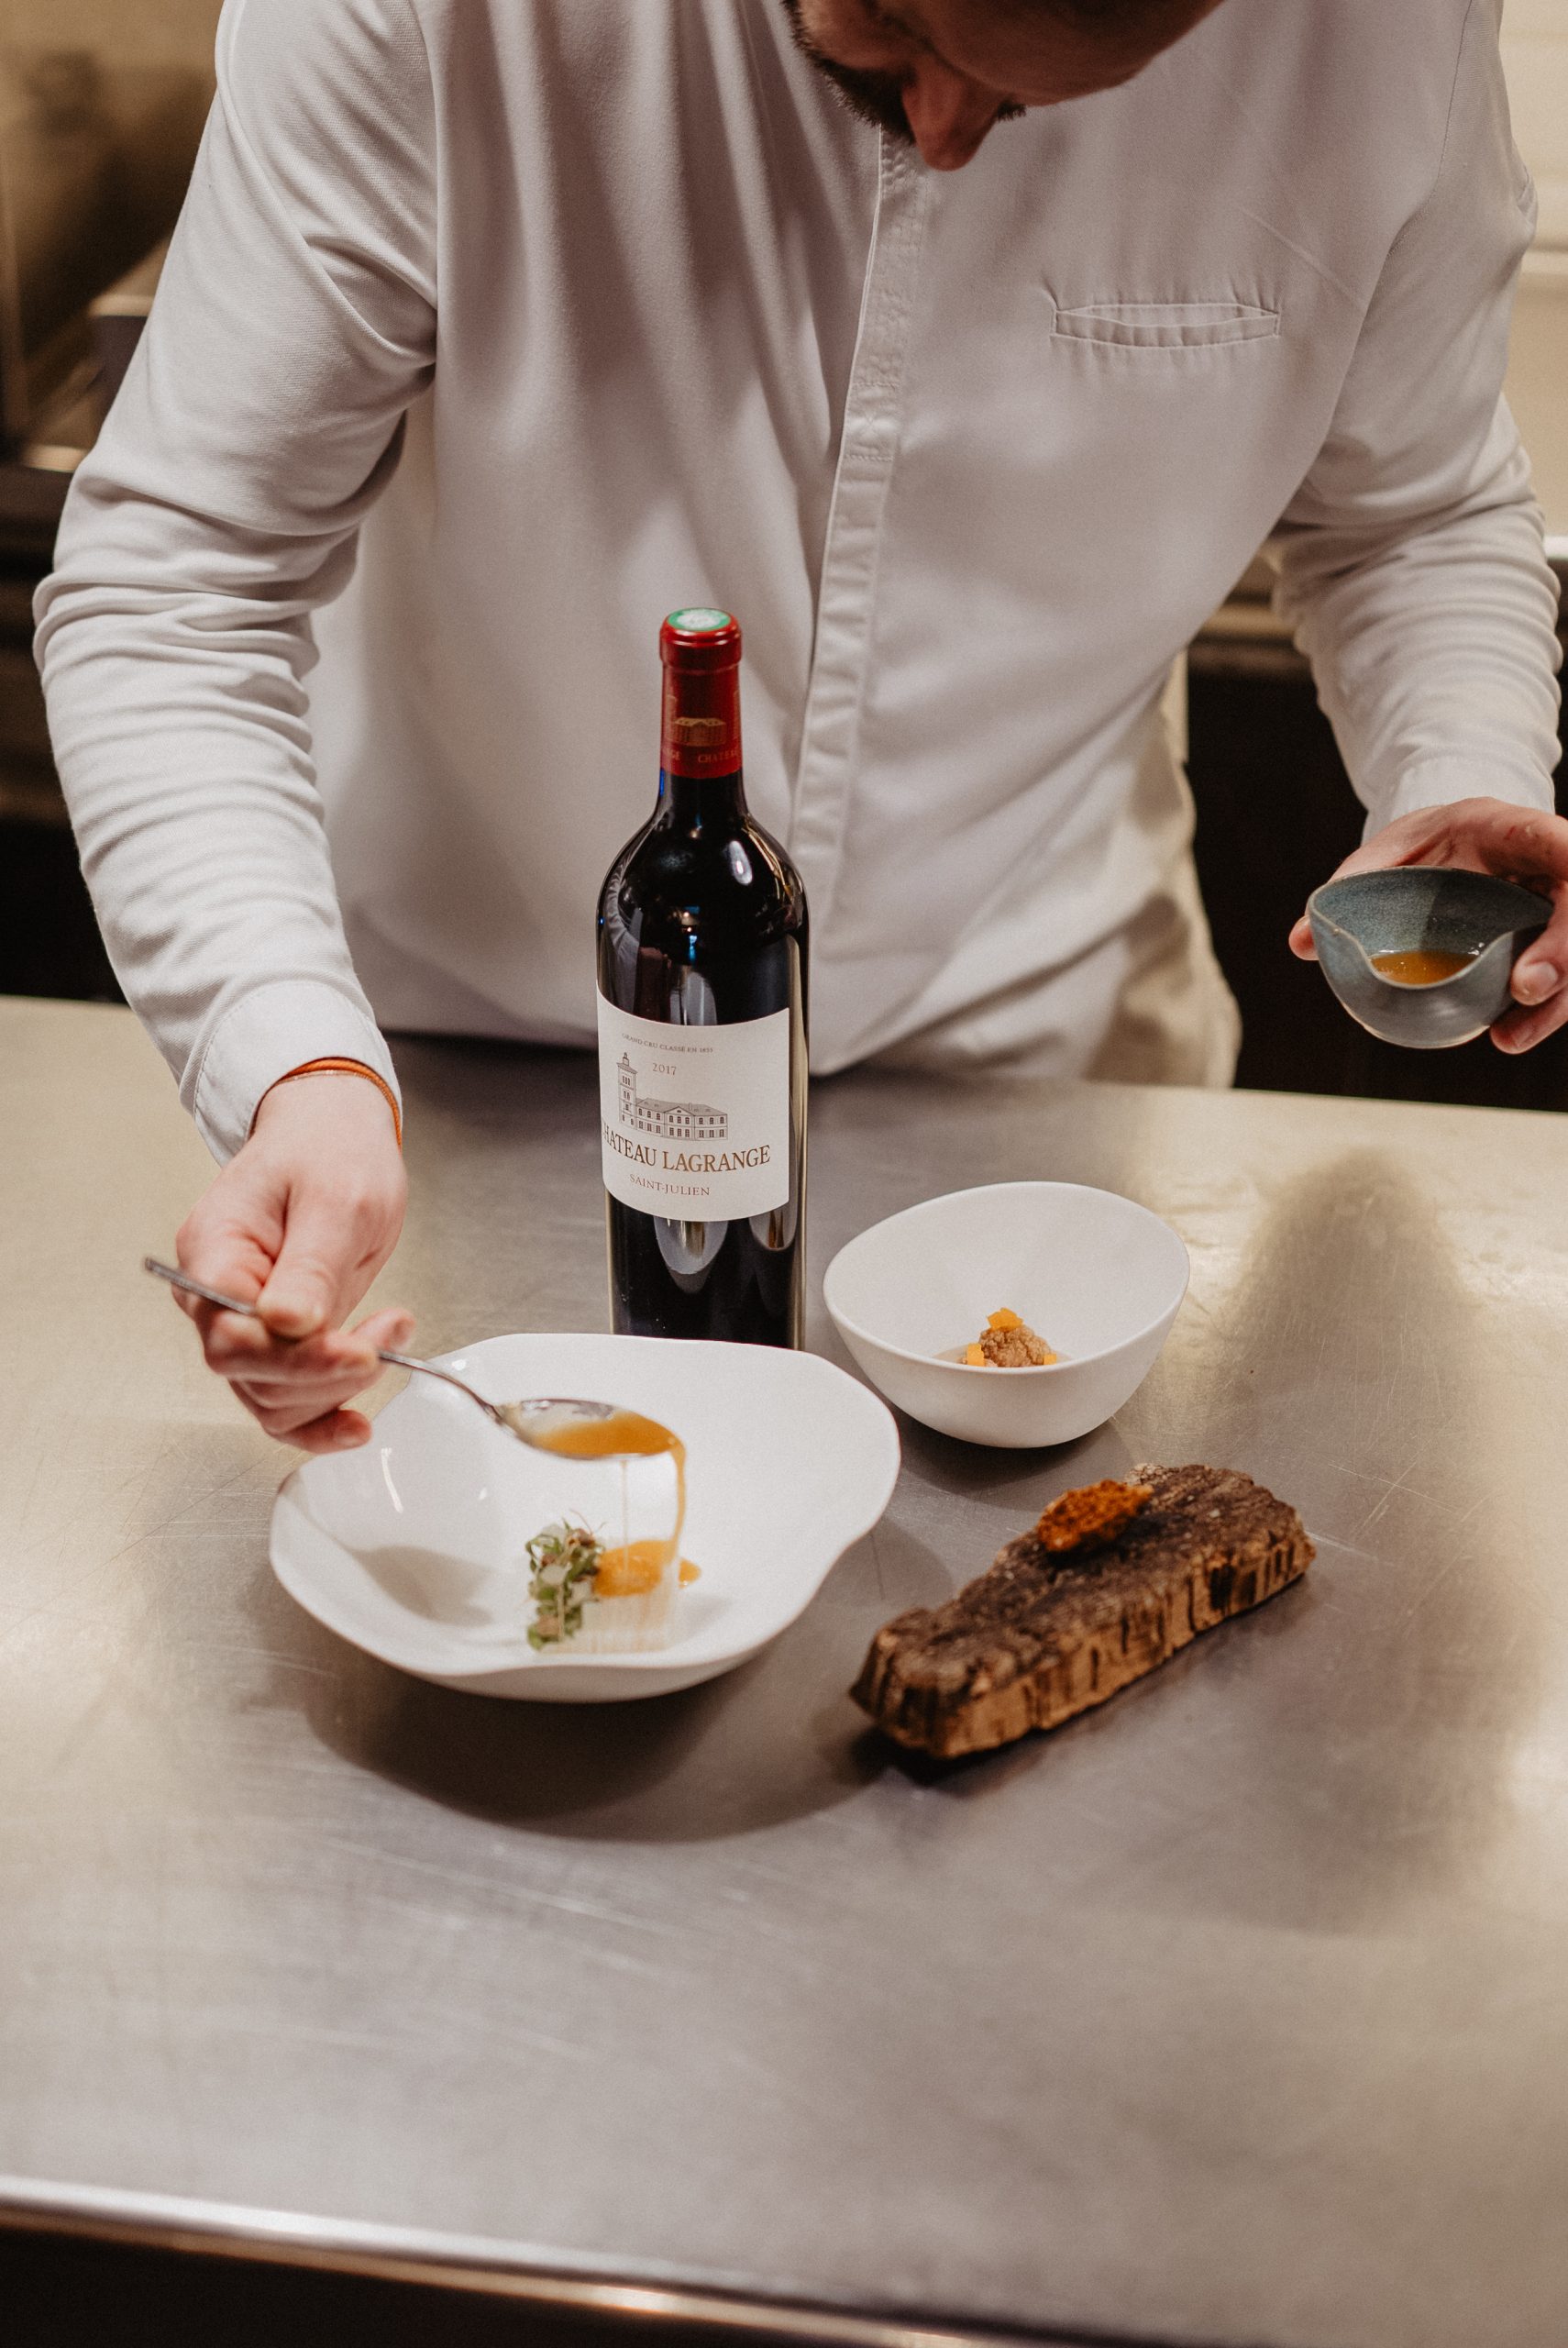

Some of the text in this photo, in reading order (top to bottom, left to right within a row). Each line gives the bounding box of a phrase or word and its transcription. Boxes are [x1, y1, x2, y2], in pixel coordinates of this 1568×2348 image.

[622, 1033, 643, 1045] GRAND
[644, 1040, 658, 1049] CRU
[652, 1063, 677, 1076] 2017
[602, 1121, 771, 1172] HATEAU LAGRANGE
[629, 1174, 711, 1196] SAINT-JULIEN
